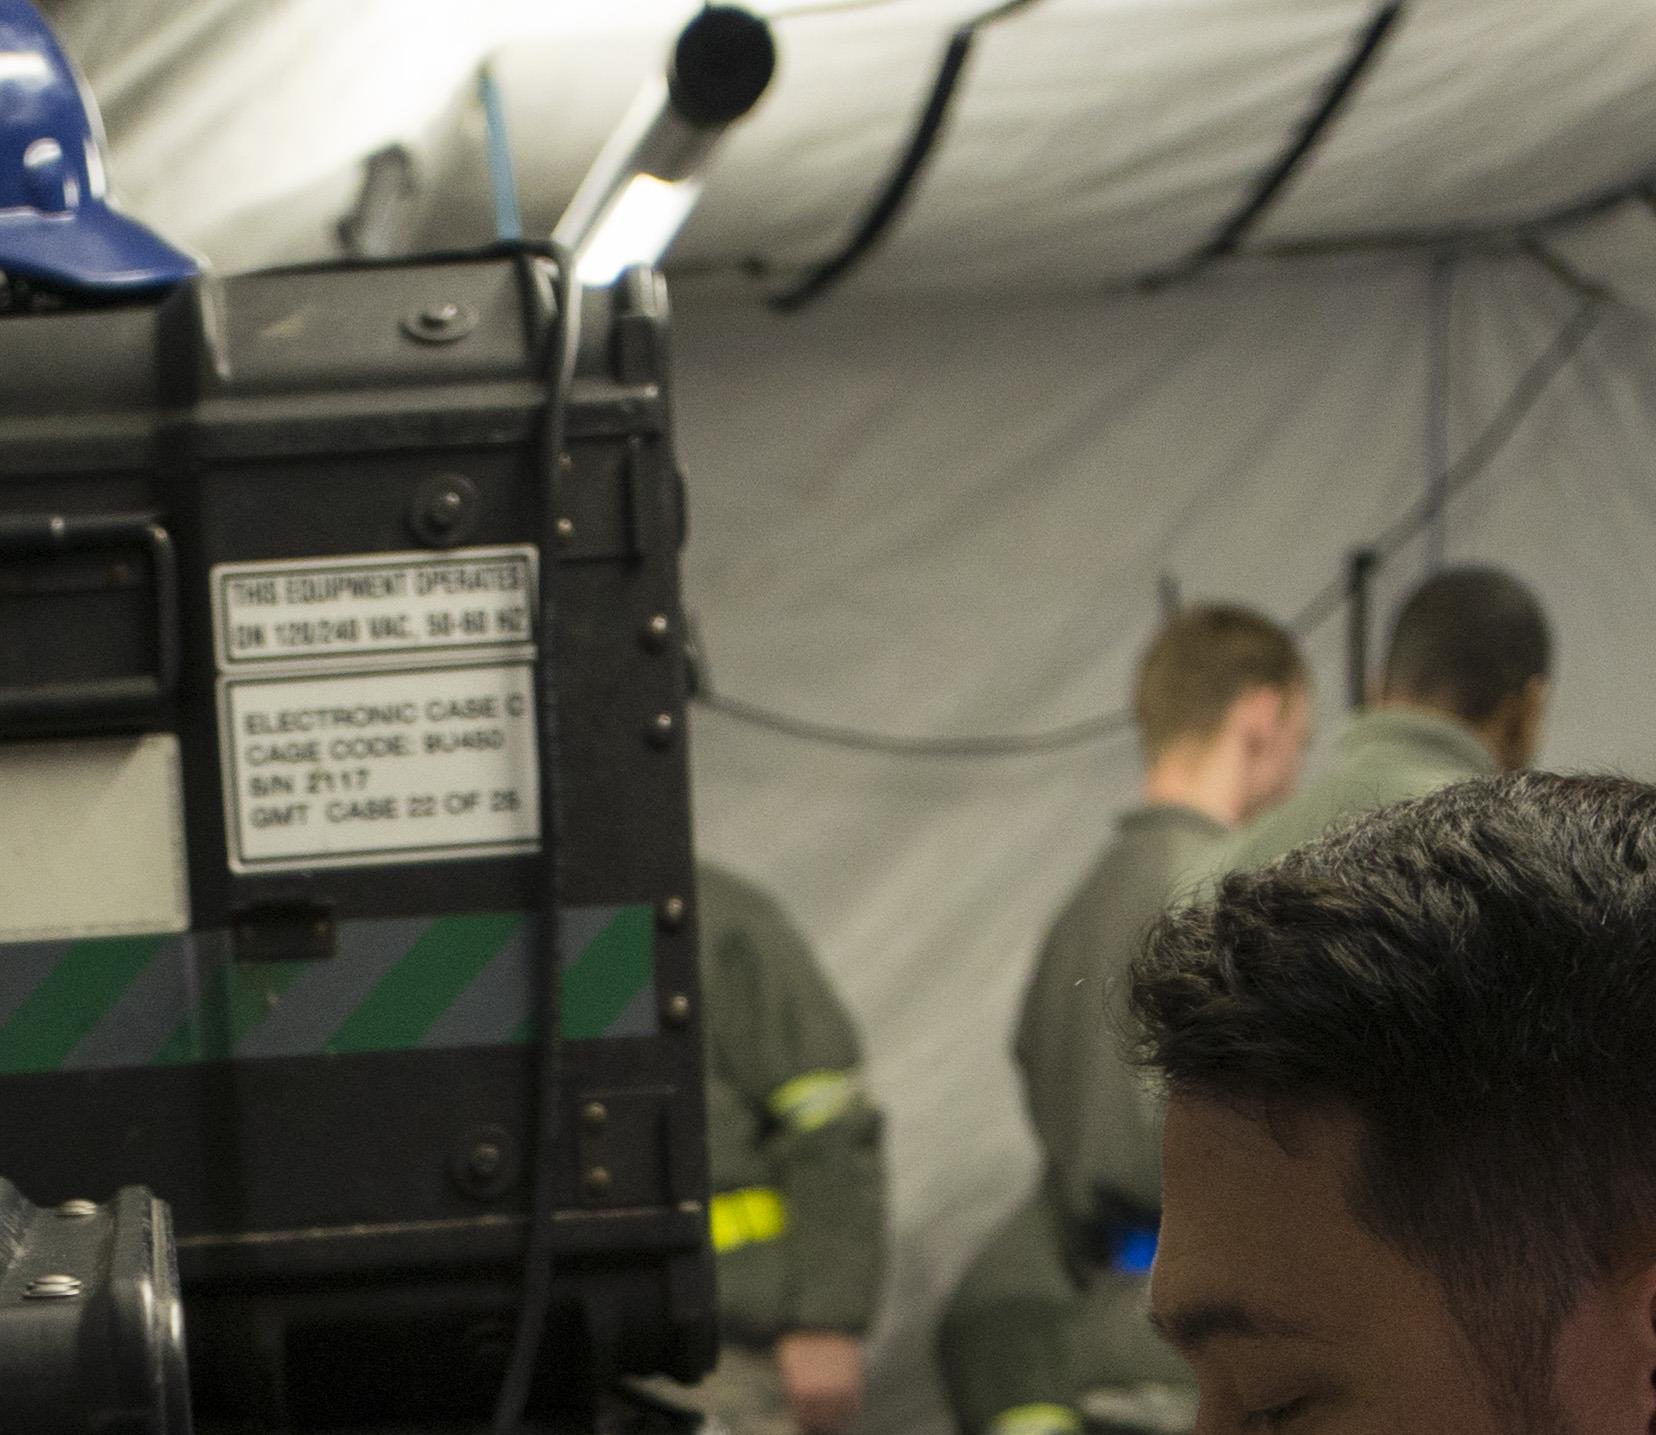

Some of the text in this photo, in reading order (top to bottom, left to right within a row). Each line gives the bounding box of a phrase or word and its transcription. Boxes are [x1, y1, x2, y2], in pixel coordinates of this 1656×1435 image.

[234, 565, 519, 606] THIS EQUIPMENT OPERATES
[237, 623, 264, 649] ON
[244, 702, 417, 735] ELECTRONIC
[425, 696, 496, 722] CASE
[245, 740, 321, 766] CAGE
[325, 796, 398, 823] CASE
